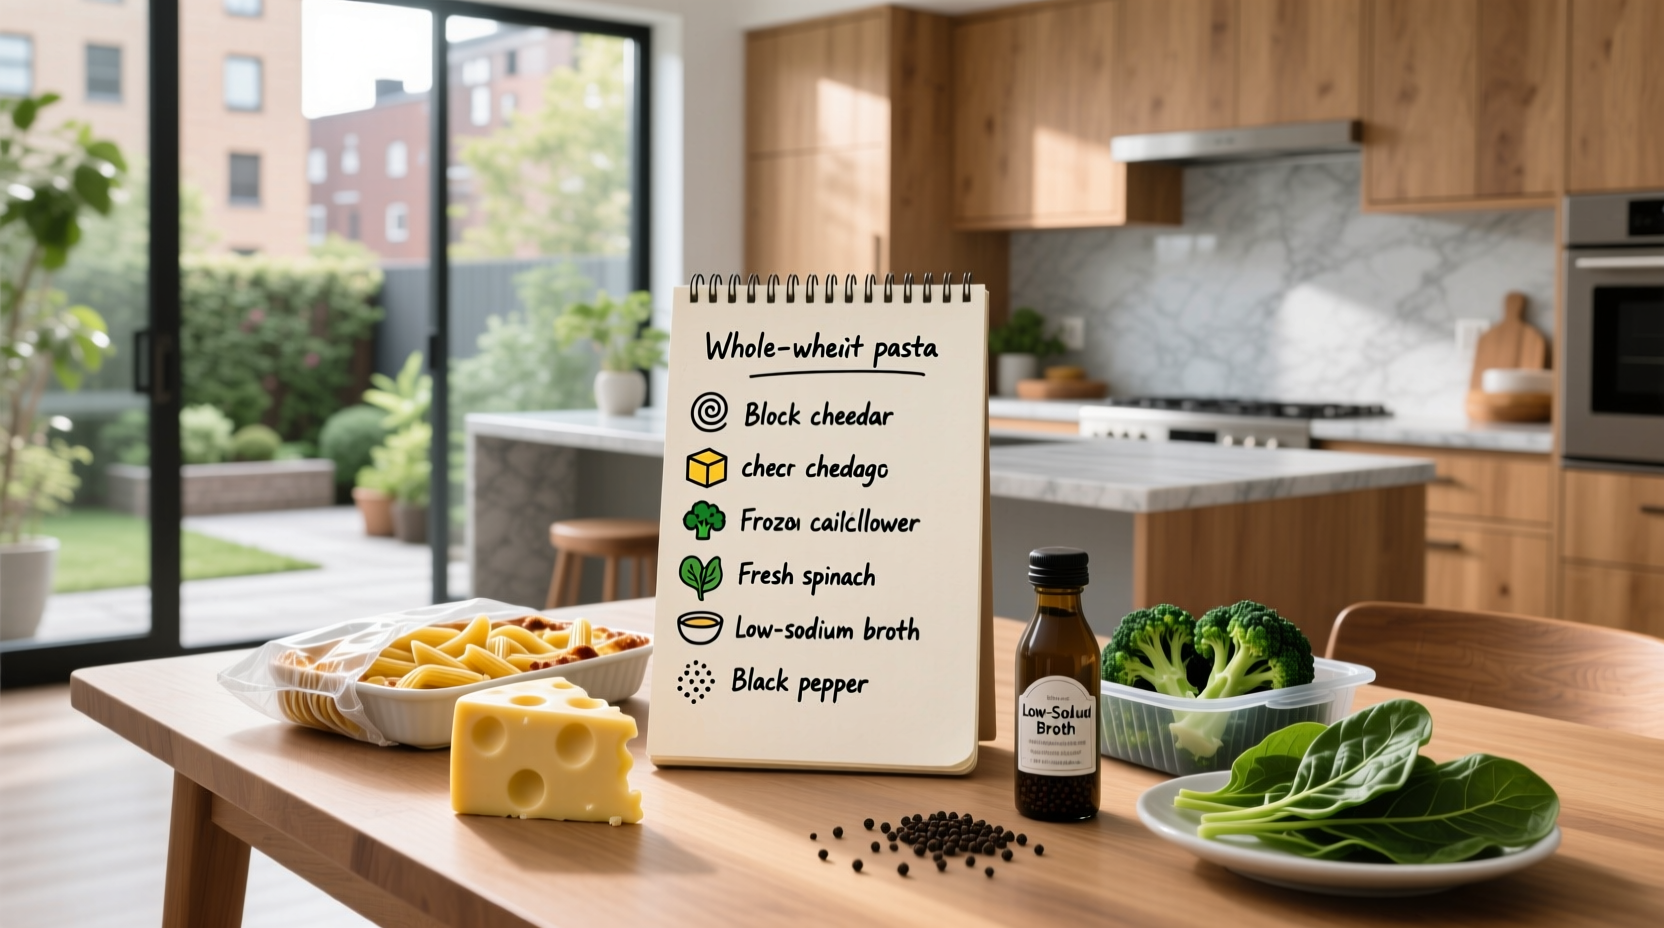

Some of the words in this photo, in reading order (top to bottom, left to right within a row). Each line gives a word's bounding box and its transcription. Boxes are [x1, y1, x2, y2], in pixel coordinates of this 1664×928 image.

[872, 335, 939, 369] pasta
[744, 400, 801, 427] Block
[810, 400, 895, 426] cheedar
[738, 561, 794, 586] Fresh
[802, 561, 876, 597] spinach
[735, 614, 854, 640] Low-sodium
[863, 616, 920, 641] broth
[731, 666, 789, 692] Black
[797, 677, 870, 704] pepper
[1036, 720, 1076, 736] Broth
